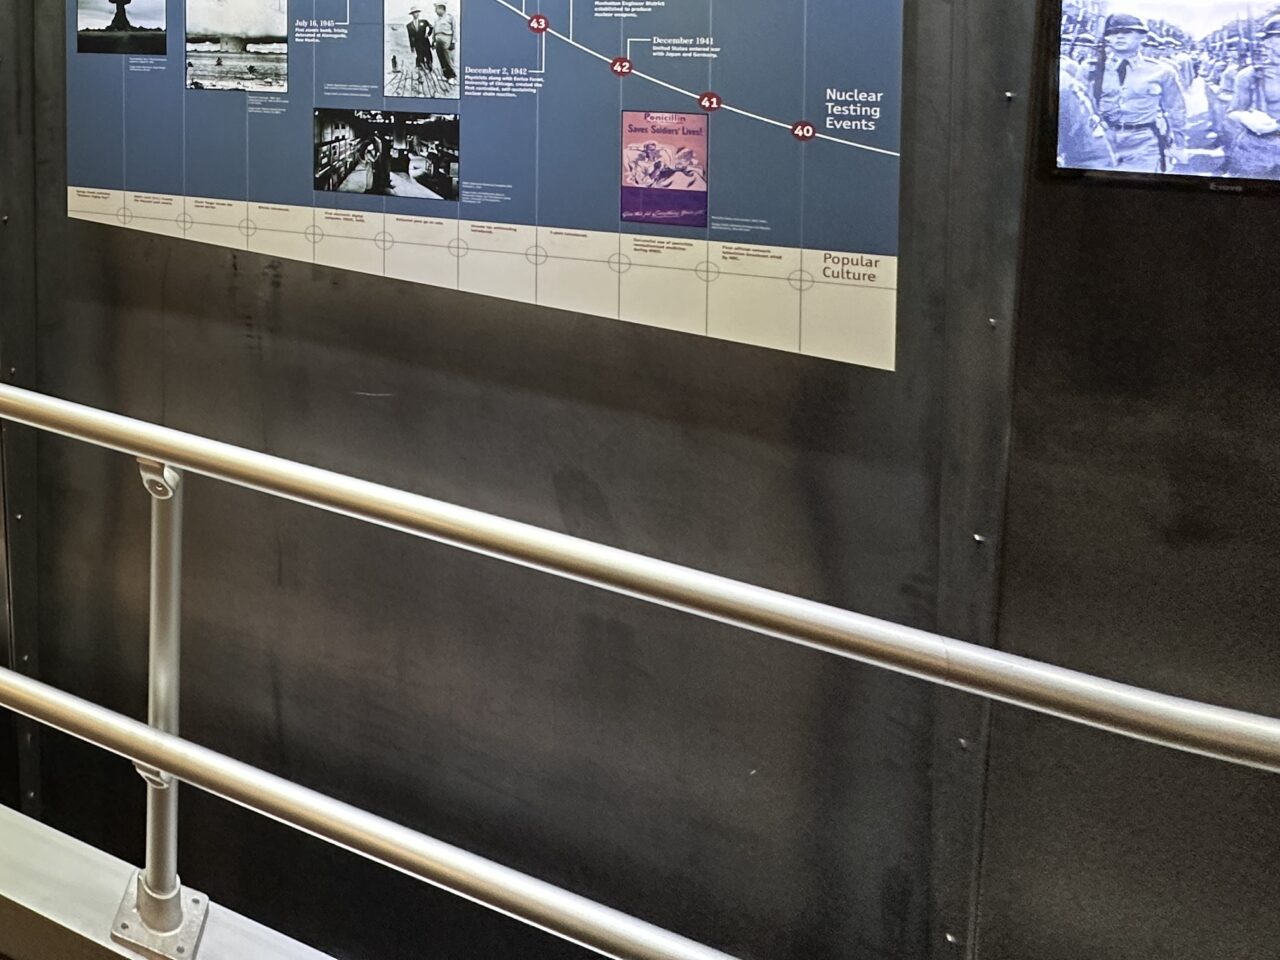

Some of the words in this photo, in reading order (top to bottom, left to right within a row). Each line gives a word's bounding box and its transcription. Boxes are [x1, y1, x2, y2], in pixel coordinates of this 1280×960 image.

[530, 19, 546, 29] 43
[696, 37, 713, 45] 1941
[465, 66, 501, 74] December
[502, 67, 509, 75] 2,
[614, 62, 630, 72] 42
[826, 88, 883, 103] Nuclear
[701, 97, 718, 108] 41
[825, 102, 880, 118] Testing
[645, 112, 686, 122] Penicillin
[825, 117, 876, 131] Events
[628, 124, 648, 134] Saves
[682, 126, 702, 136] Lives!
[795, 126, 813, 137] 40
[823, 252, 880, 268] Popular
[822, 267, 876, 282] Culture
